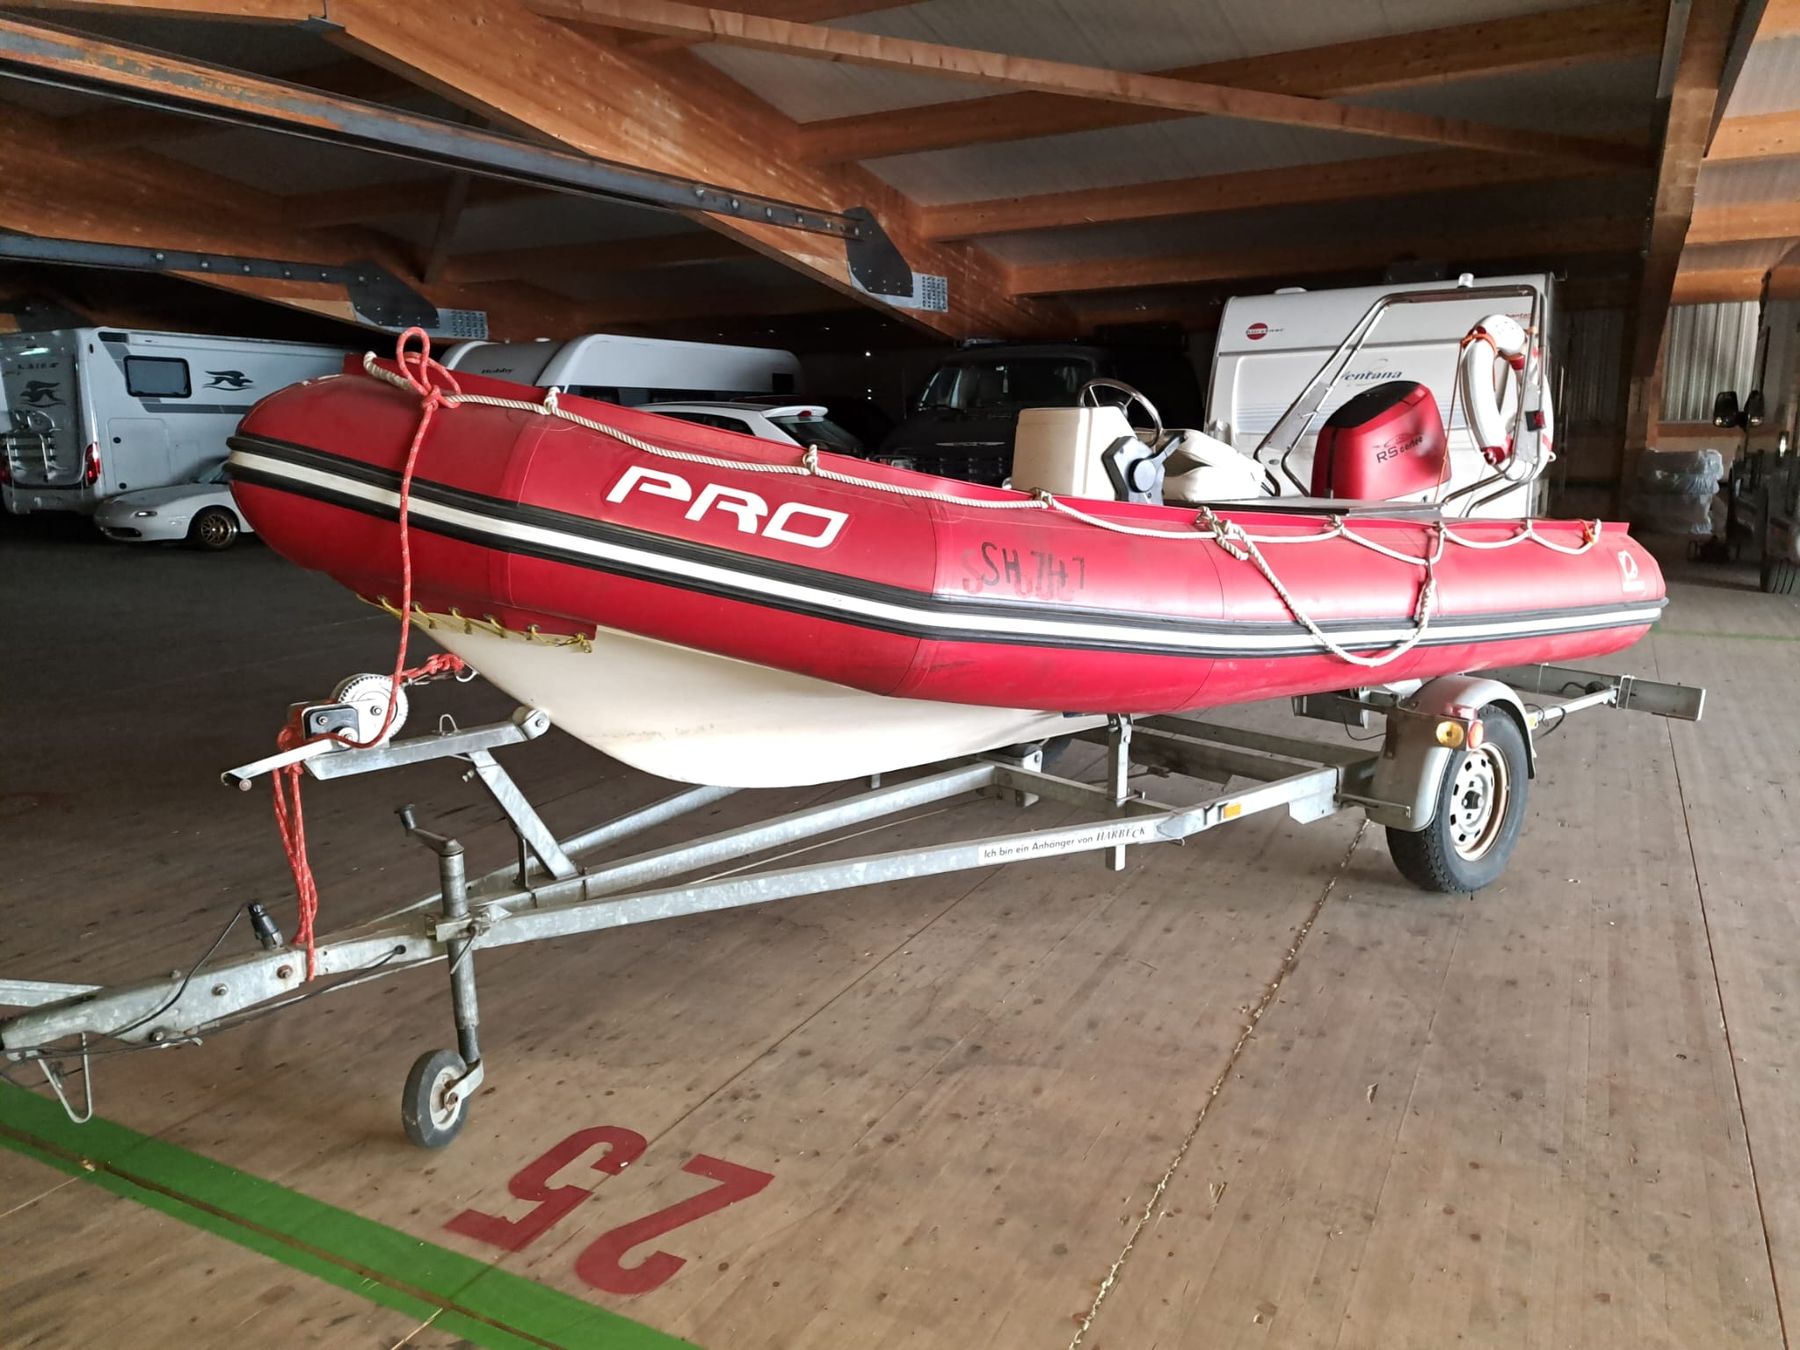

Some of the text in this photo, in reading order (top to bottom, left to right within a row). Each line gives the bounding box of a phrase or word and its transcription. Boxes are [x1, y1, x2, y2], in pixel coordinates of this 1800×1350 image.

[1376, 446, 1398, 463] RS
[606, 465, 849, 549] PRO
[984, 849, 997, 858] Ich
[1000, 846, 1014, 856] bin
[1016, 845, 1029, 854] ein
[1077, 836, 1093, 844] von
[442, 1125, 776, 1295] 25
